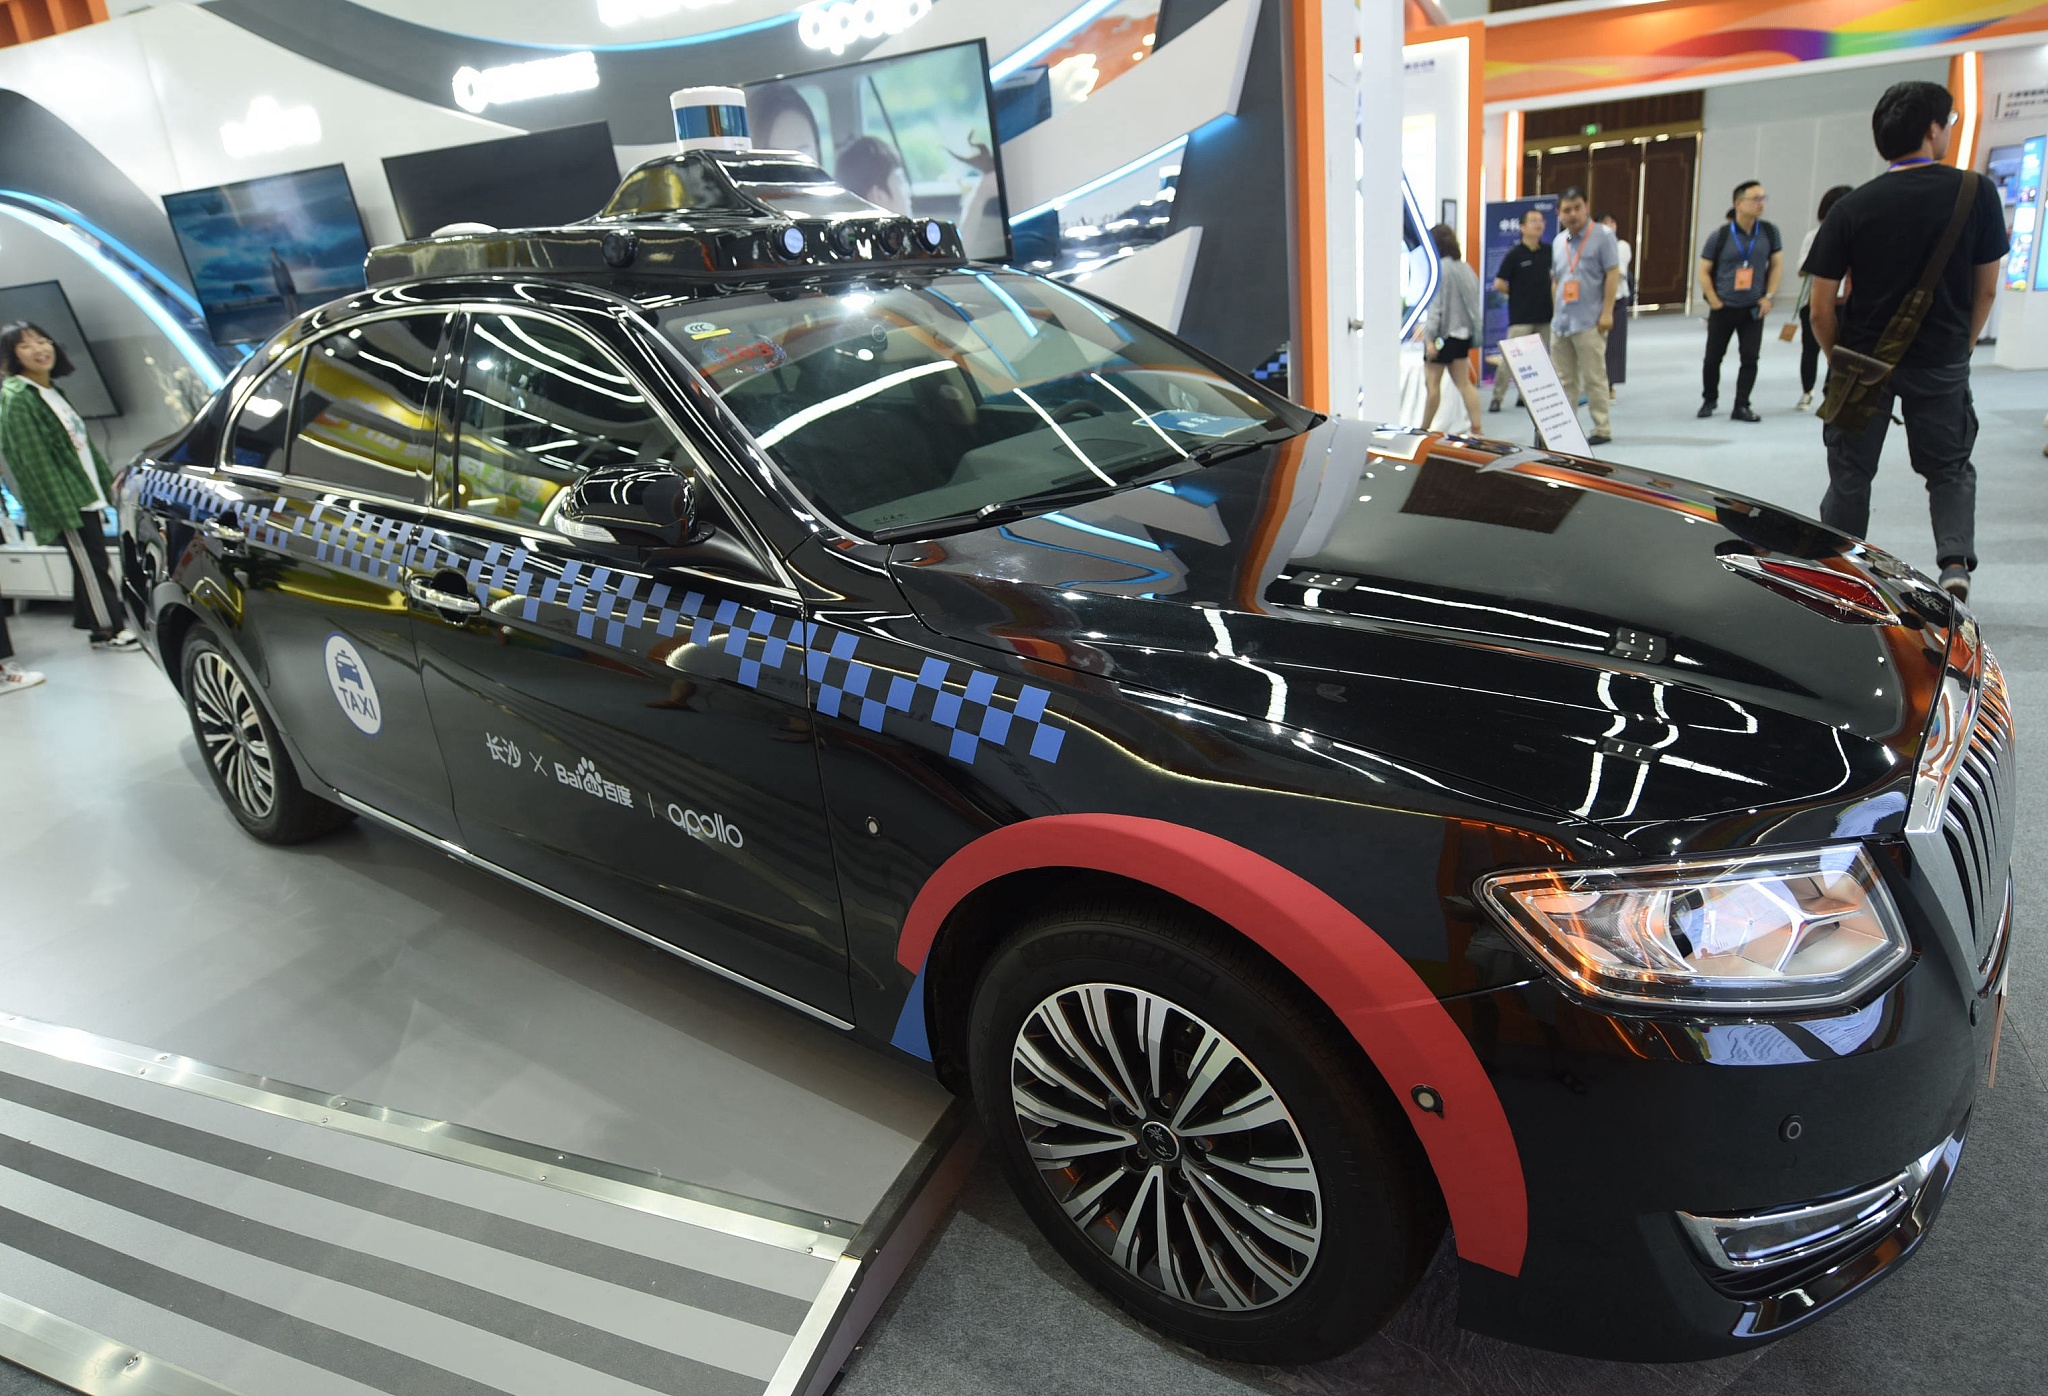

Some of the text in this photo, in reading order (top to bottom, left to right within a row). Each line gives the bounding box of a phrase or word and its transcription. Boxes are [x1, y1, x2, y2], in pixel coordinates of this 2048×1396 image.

[338, 686, 378, 721] TAXI
[486, 732, 521, 768] 长沙
[667, 803, 744, 848] apollo
